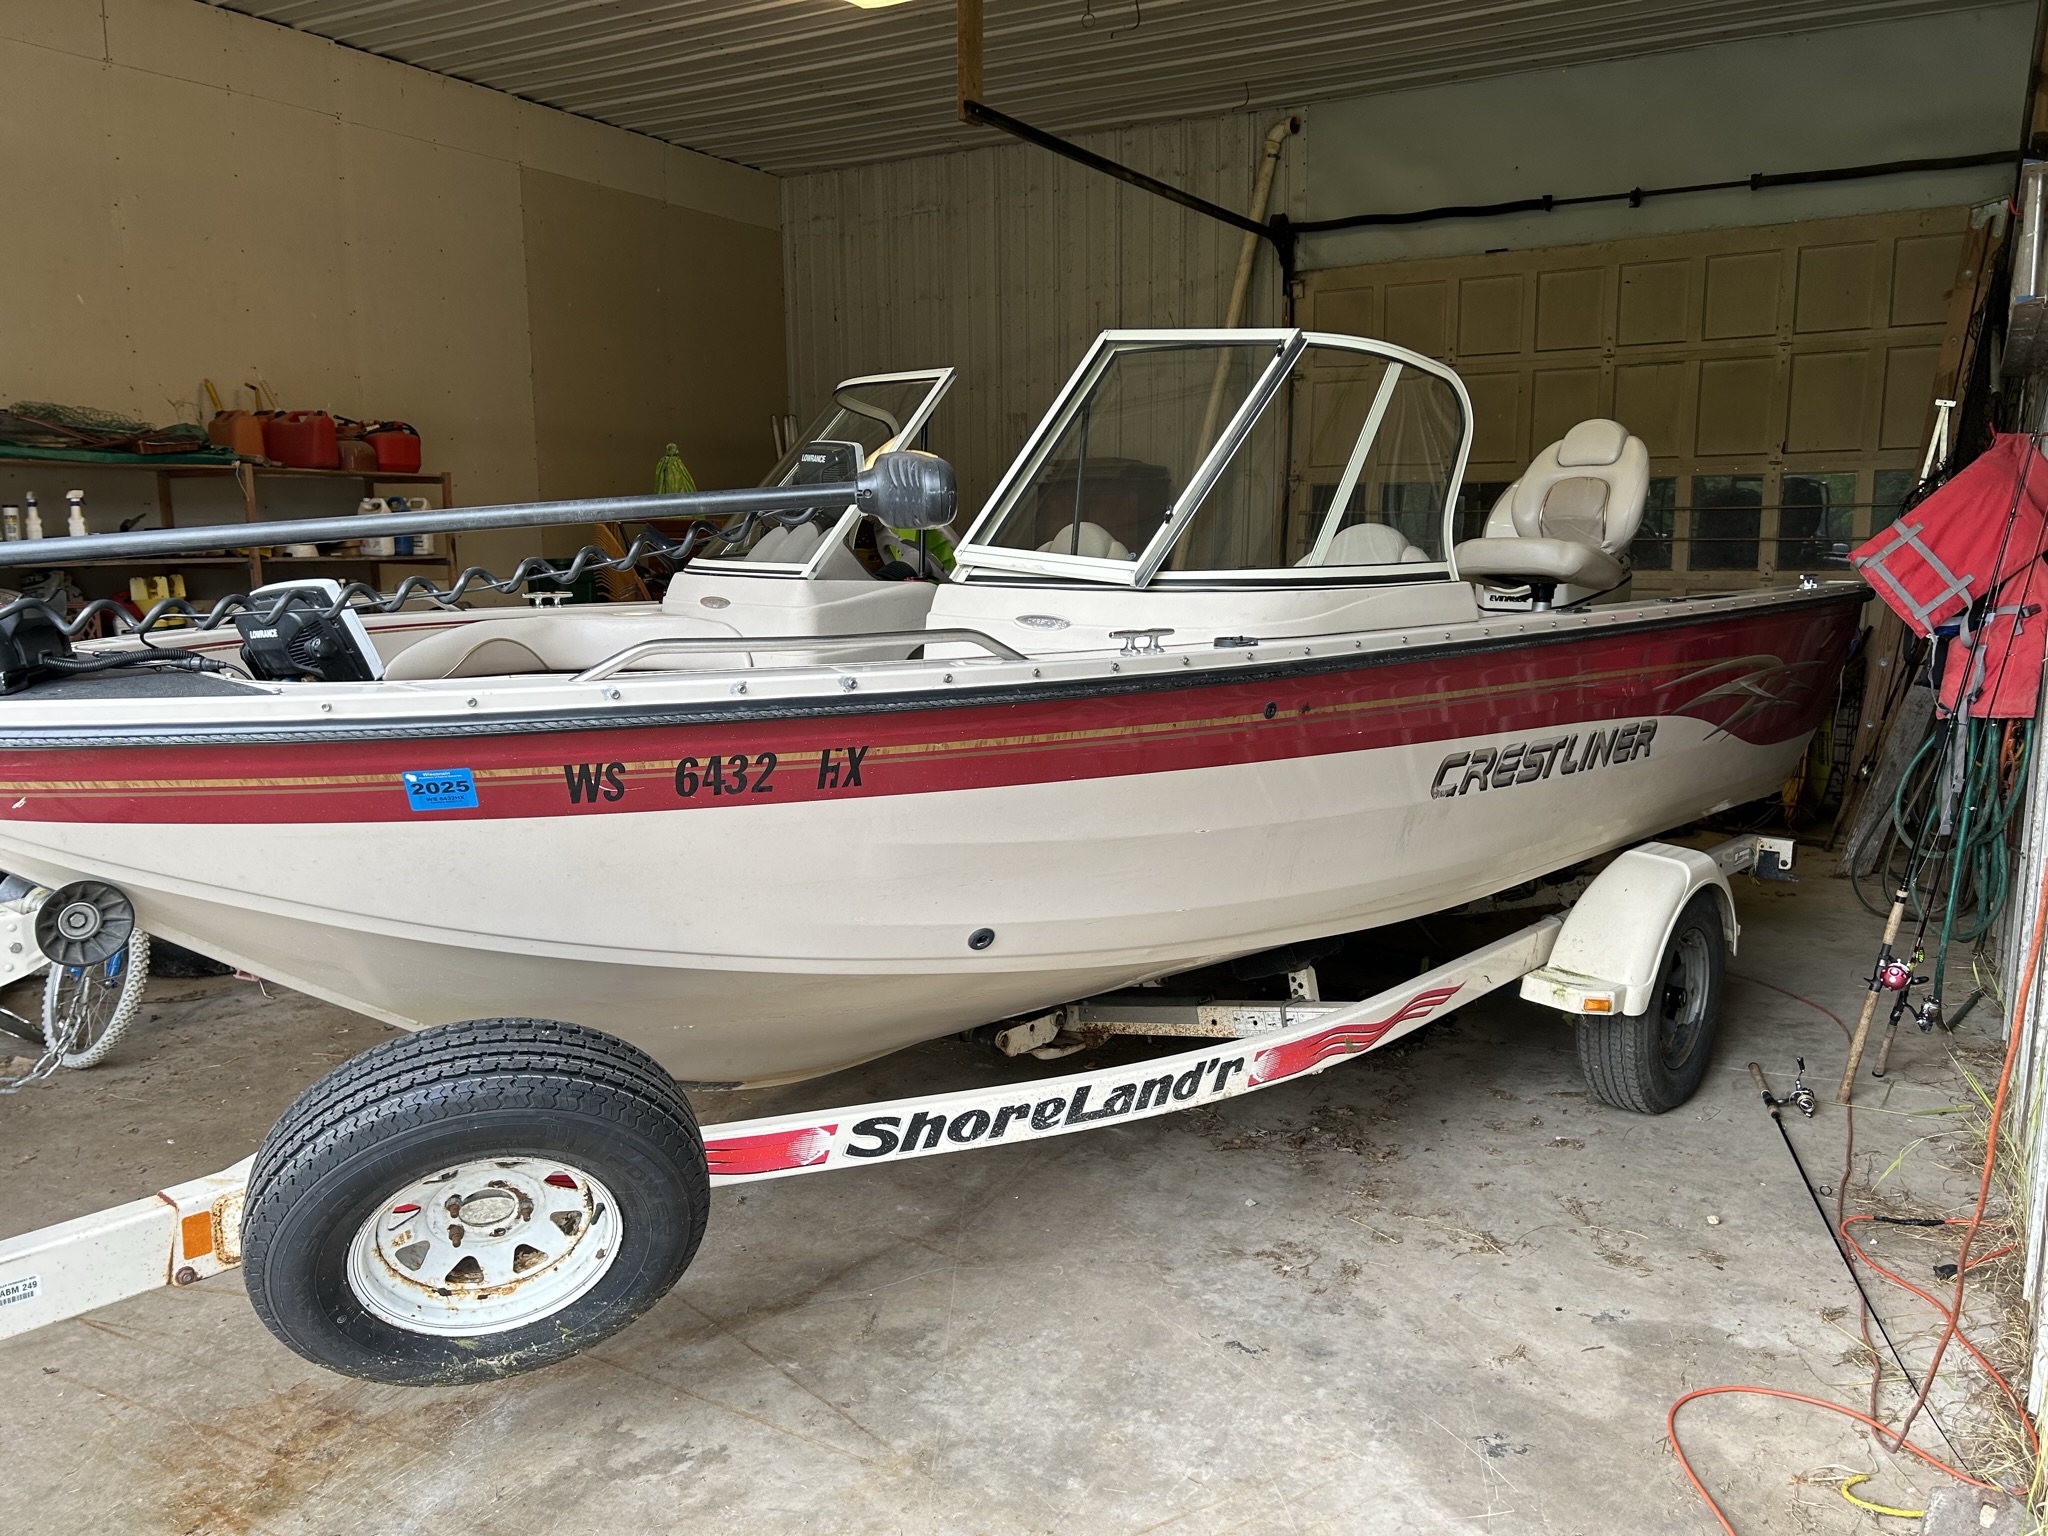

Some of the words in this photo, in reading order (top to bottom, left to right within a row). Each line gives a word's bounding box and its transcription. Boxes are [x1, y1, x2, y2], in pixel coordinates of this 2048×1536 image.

[410, 780, 470, 796] 2025
[563, 762, 626, 804] WS
[674, 752, 778, 797] 6432
[817, 746, 869, 790] HX
[1430, 719, 1658, 800] CRESTLINER
[845, 1055, 1245, 1158] ShoreLand'r
[22, 1280, 38, 1292] 249
